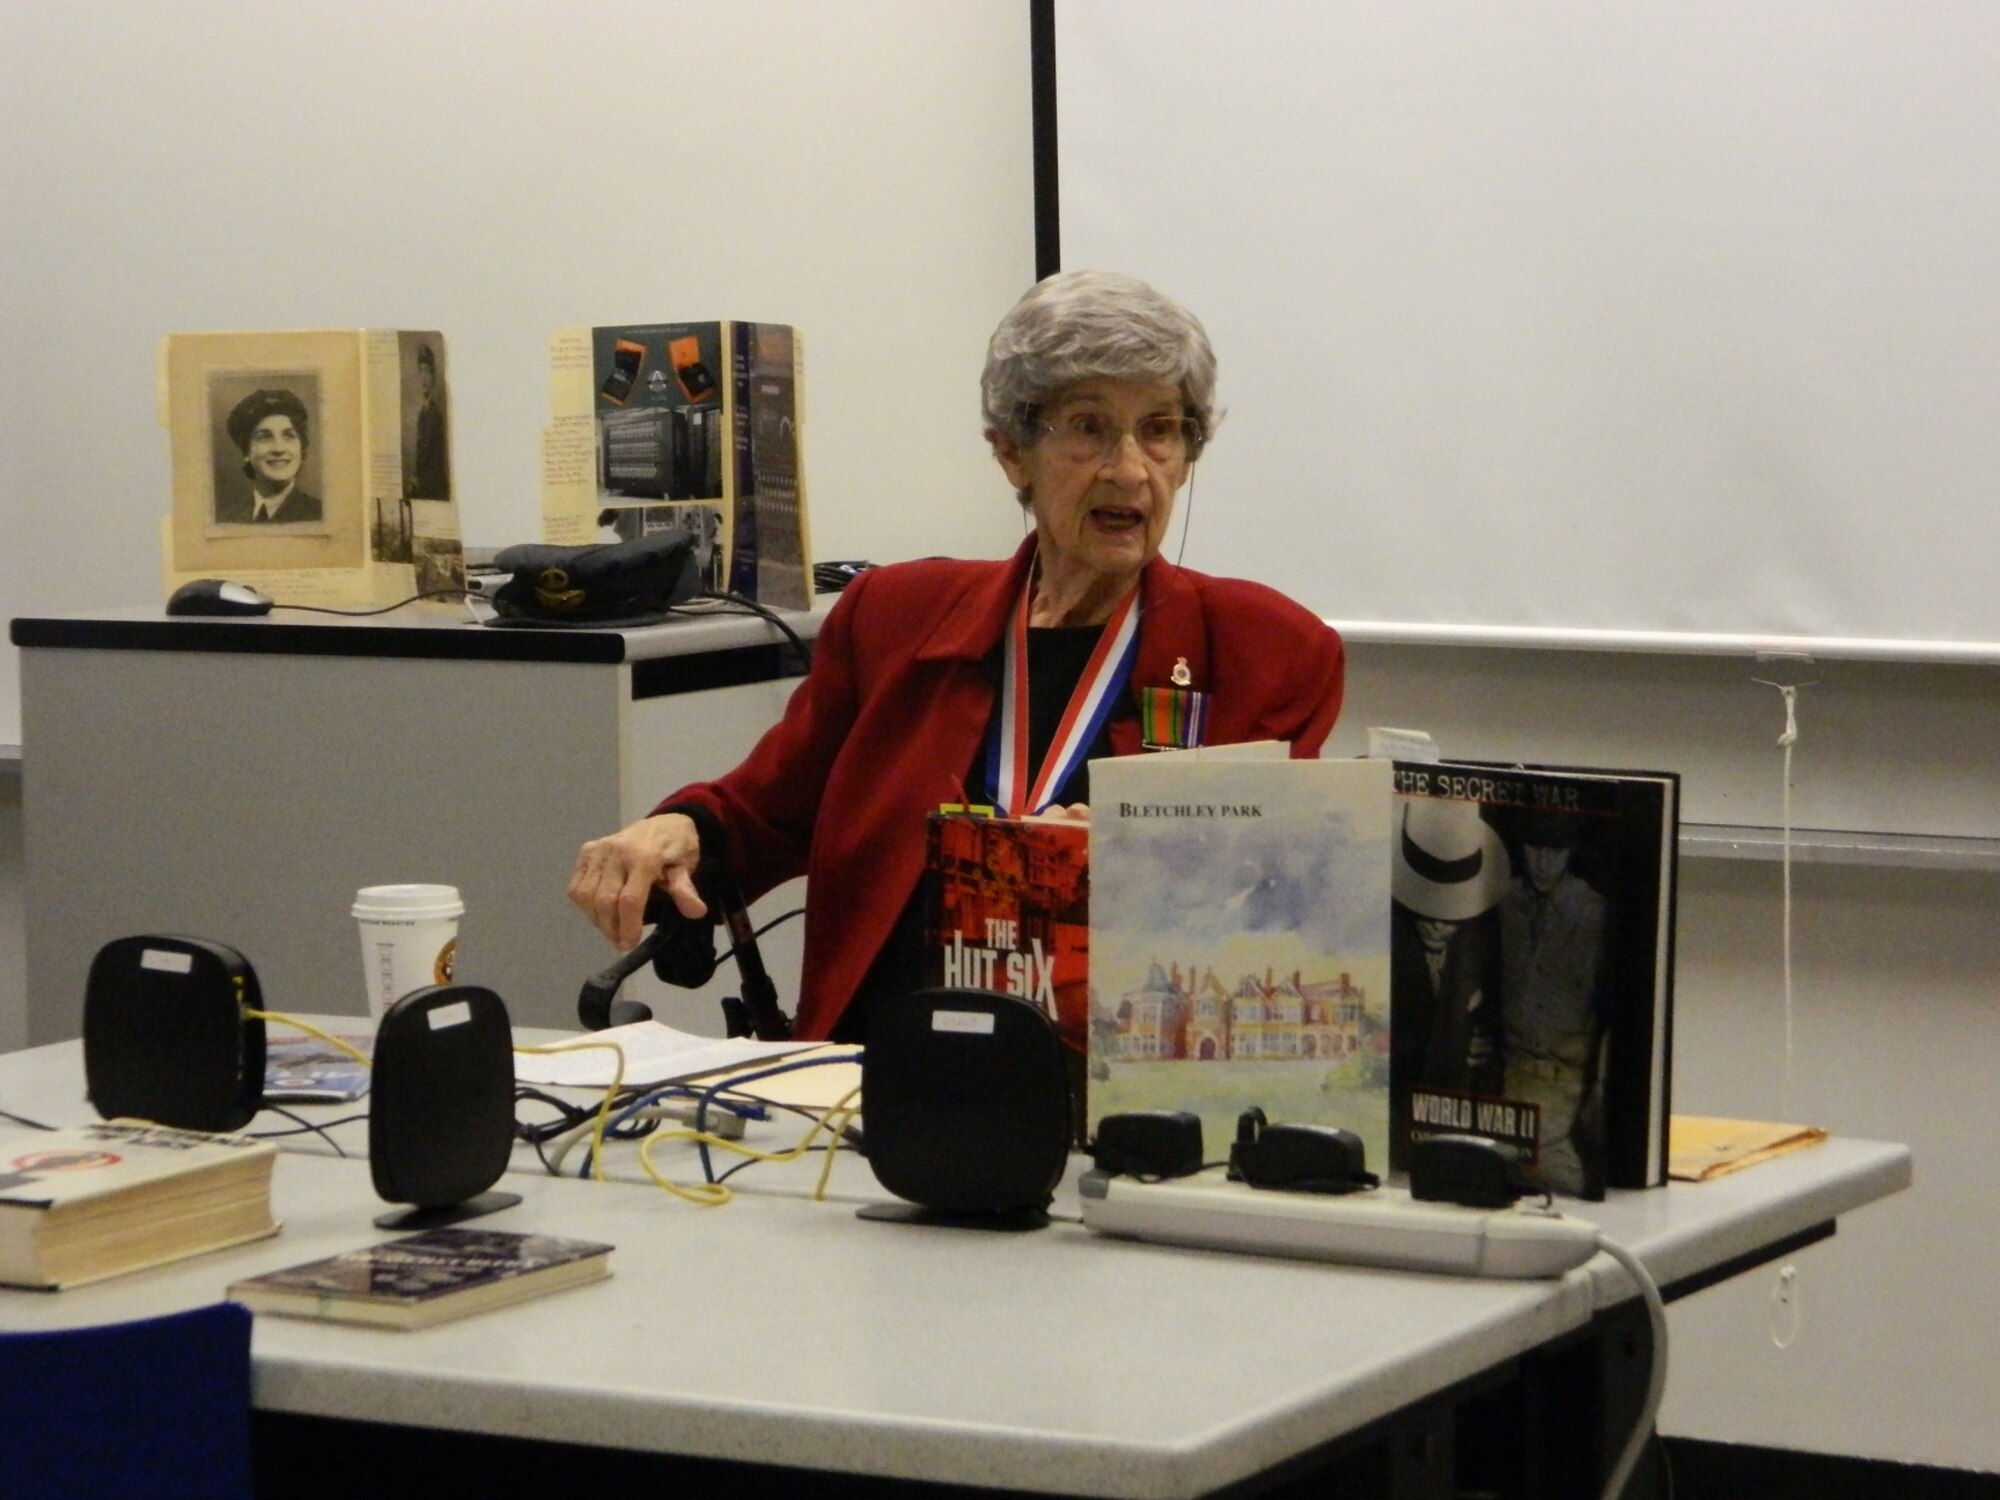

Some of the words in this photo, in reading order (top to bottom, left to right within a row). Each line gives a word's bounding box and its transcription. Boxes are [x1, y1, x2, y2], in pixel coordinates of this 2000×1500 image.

[1119, 803, 1214, 818] BLETCHLEY
[1221, 804, 1262, 818] PARK
[1437, 774, 1526, 806] SECRET
[1532, 783, 1579, 811] WAR
[984, 918, 1017, 950] THE
[944, 930, 997, 991] HUT
[1006, 938, 1058, 1022] SIX
[1412, 1092, 1472, 1129] WORLD
[1477, 1102, 1516, 1136] WAR
[1520, 1108, 1535, 1140] II
